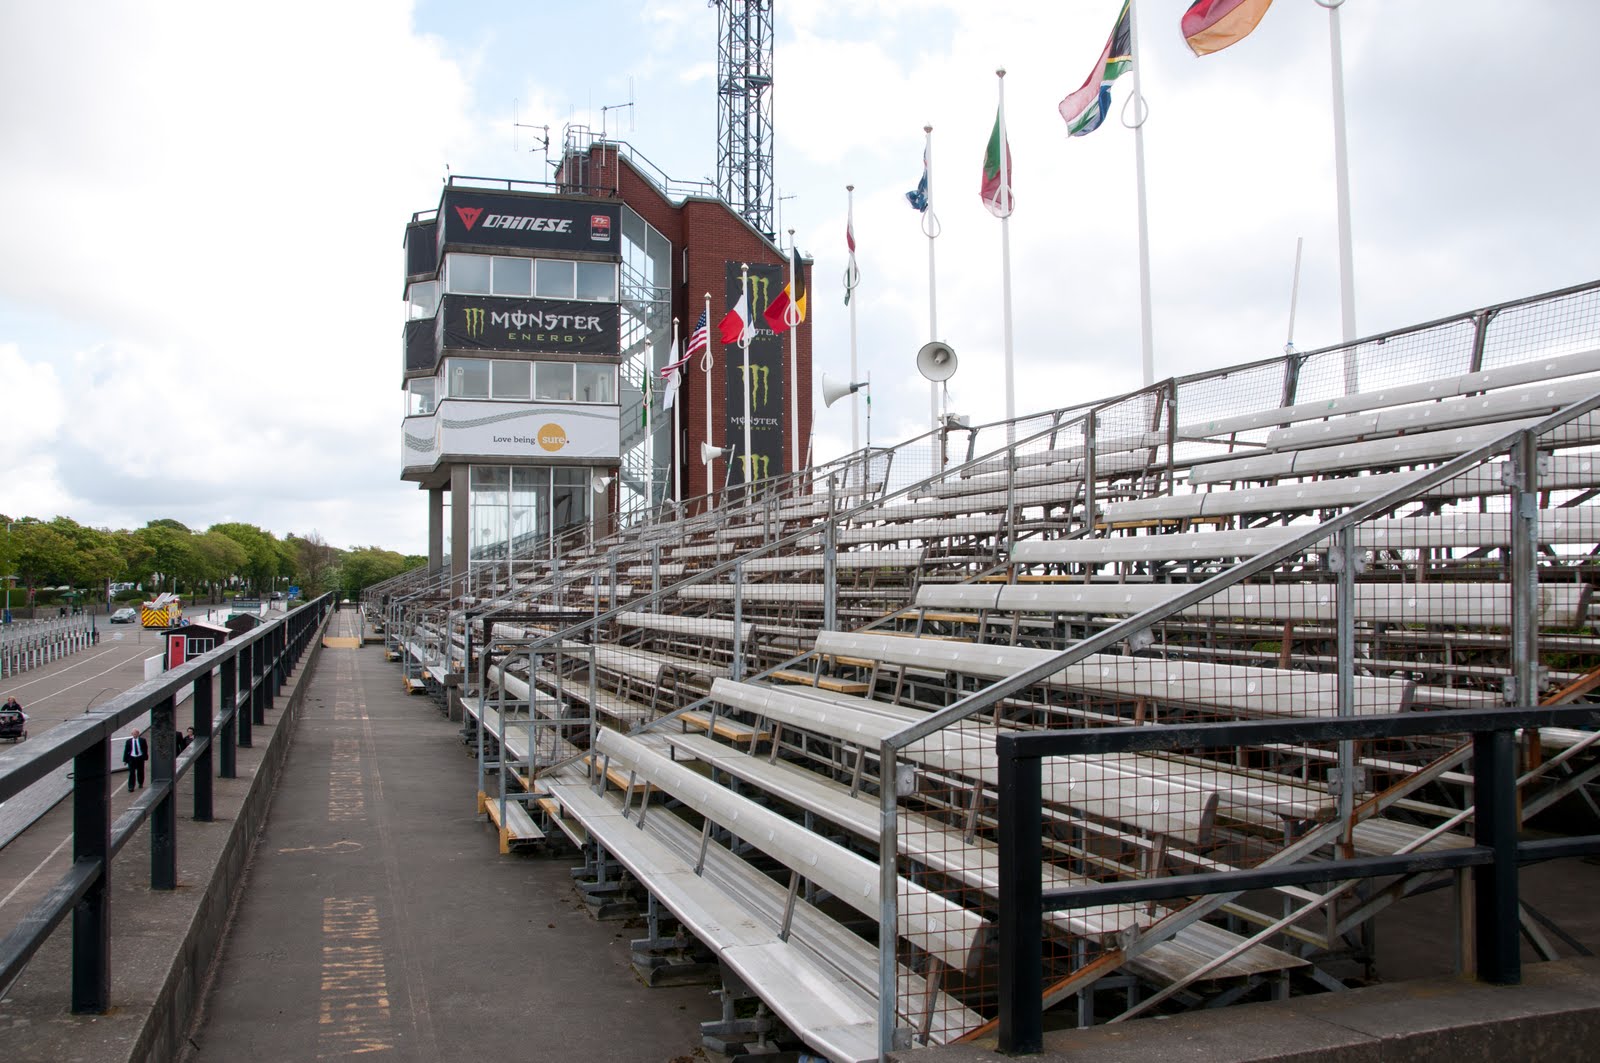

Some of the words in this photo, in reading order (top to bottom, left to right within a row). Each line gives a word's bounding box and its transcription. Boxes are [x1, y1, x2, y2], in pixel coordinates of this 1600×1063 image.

[482, 214, 573, 233] DAINESE
[490, 310, 603, 333] MONSTER
[508, 333, 587, 343] ENERGY
[493, 435, 512, 443] Love
[513, 435, 536, 446] being
